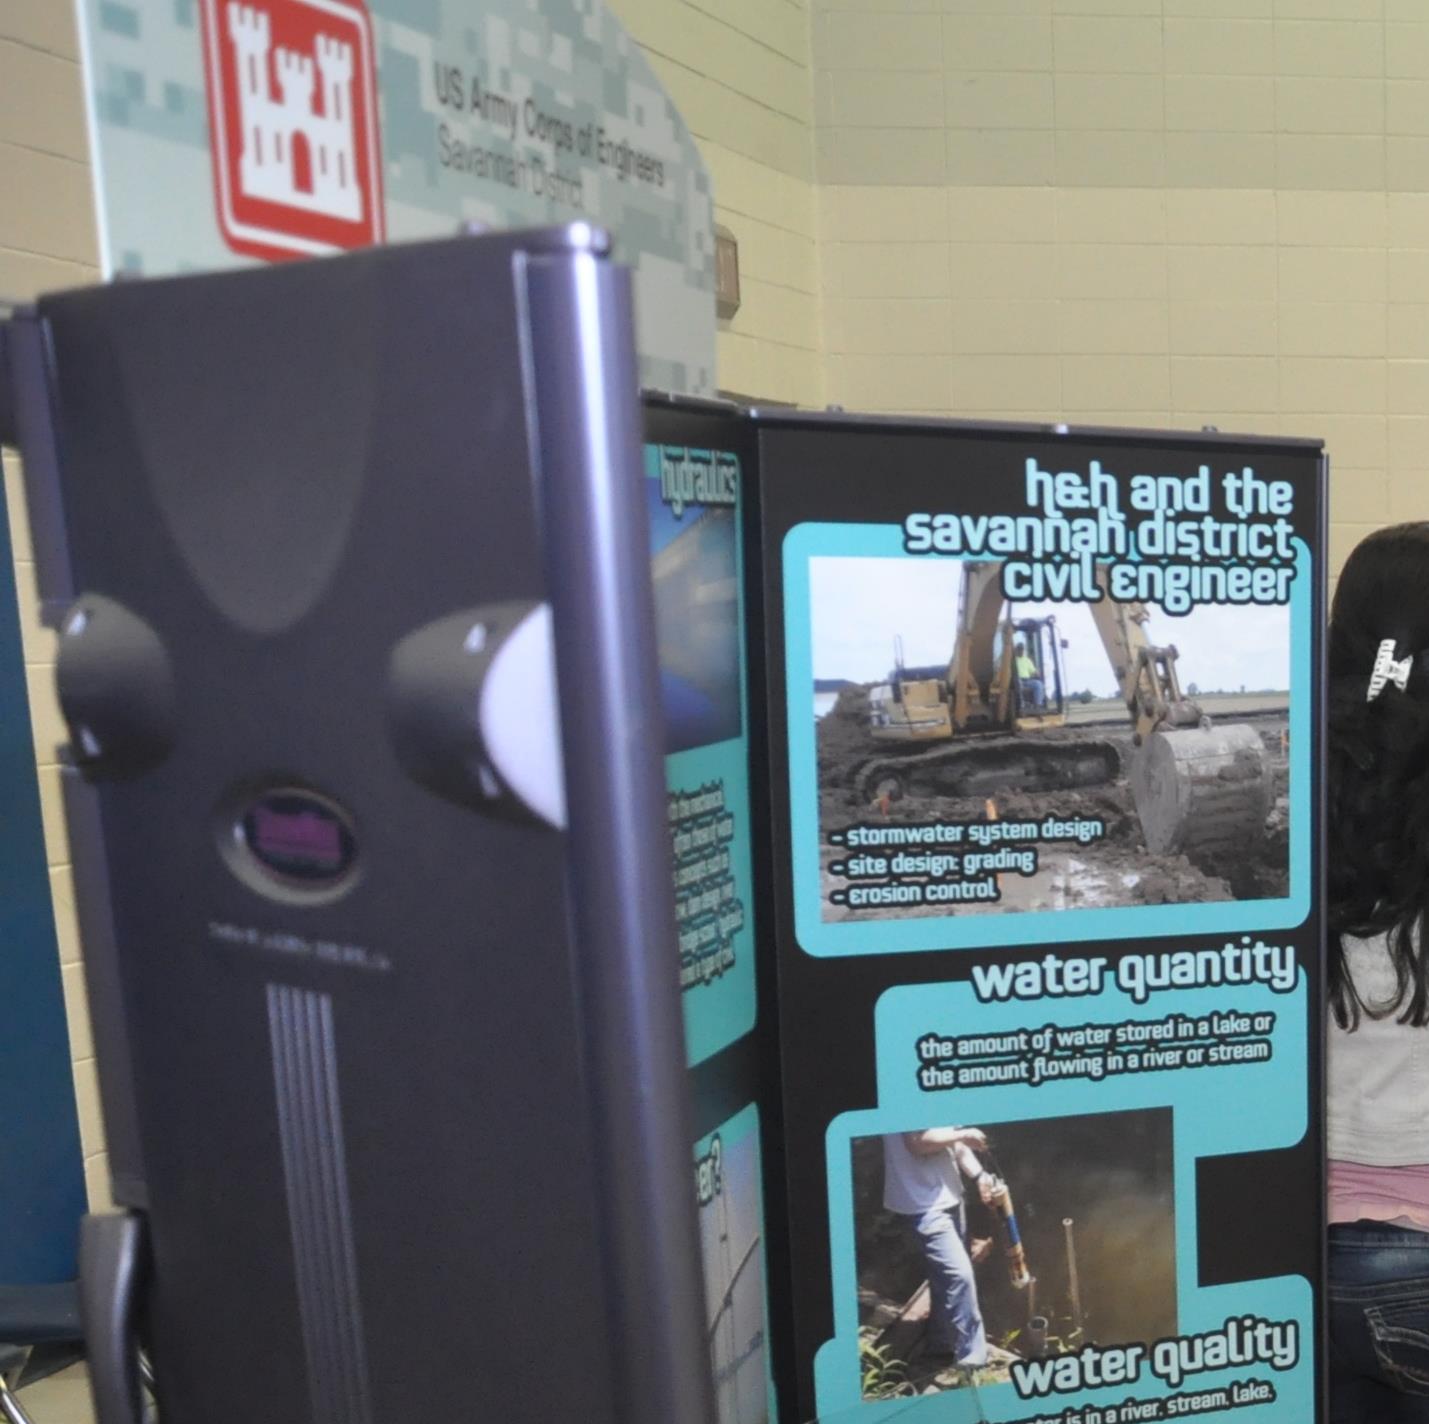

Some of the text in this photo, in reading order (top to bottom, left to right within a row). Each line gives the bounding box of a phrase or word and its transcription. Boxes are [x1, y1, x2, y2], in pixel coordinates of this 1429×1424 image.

[434, 62, 664, 187] US Army Corps of Engineers
[1130, 466, 1209, 513] and
[1222, 468, 1293, 518] the
[906, 506, 1294, 559] savannah district
[1004, 552, 1293, 612] civil engineer
[847, 825, 964, 845] stormwater
[968, 823, 1038, 844] system
[1042, 818, 1101, 841] design
[848, 854, 887, 875] site
[963, 849, 1034, 874] grading
[849, 882, 922, 904] erosion
[925, 878, 996, 899] control
[973, 937, 1295, 999] water quantity
[920, 1015, 1272, 1058] the amount of water stored in a lake or
[921, 1041, 1268, 1088] the amount flowing in a river or stream
[1011, 1319, 1296, 1395] water quality
[1105, 1410, 1117, 1424] a
